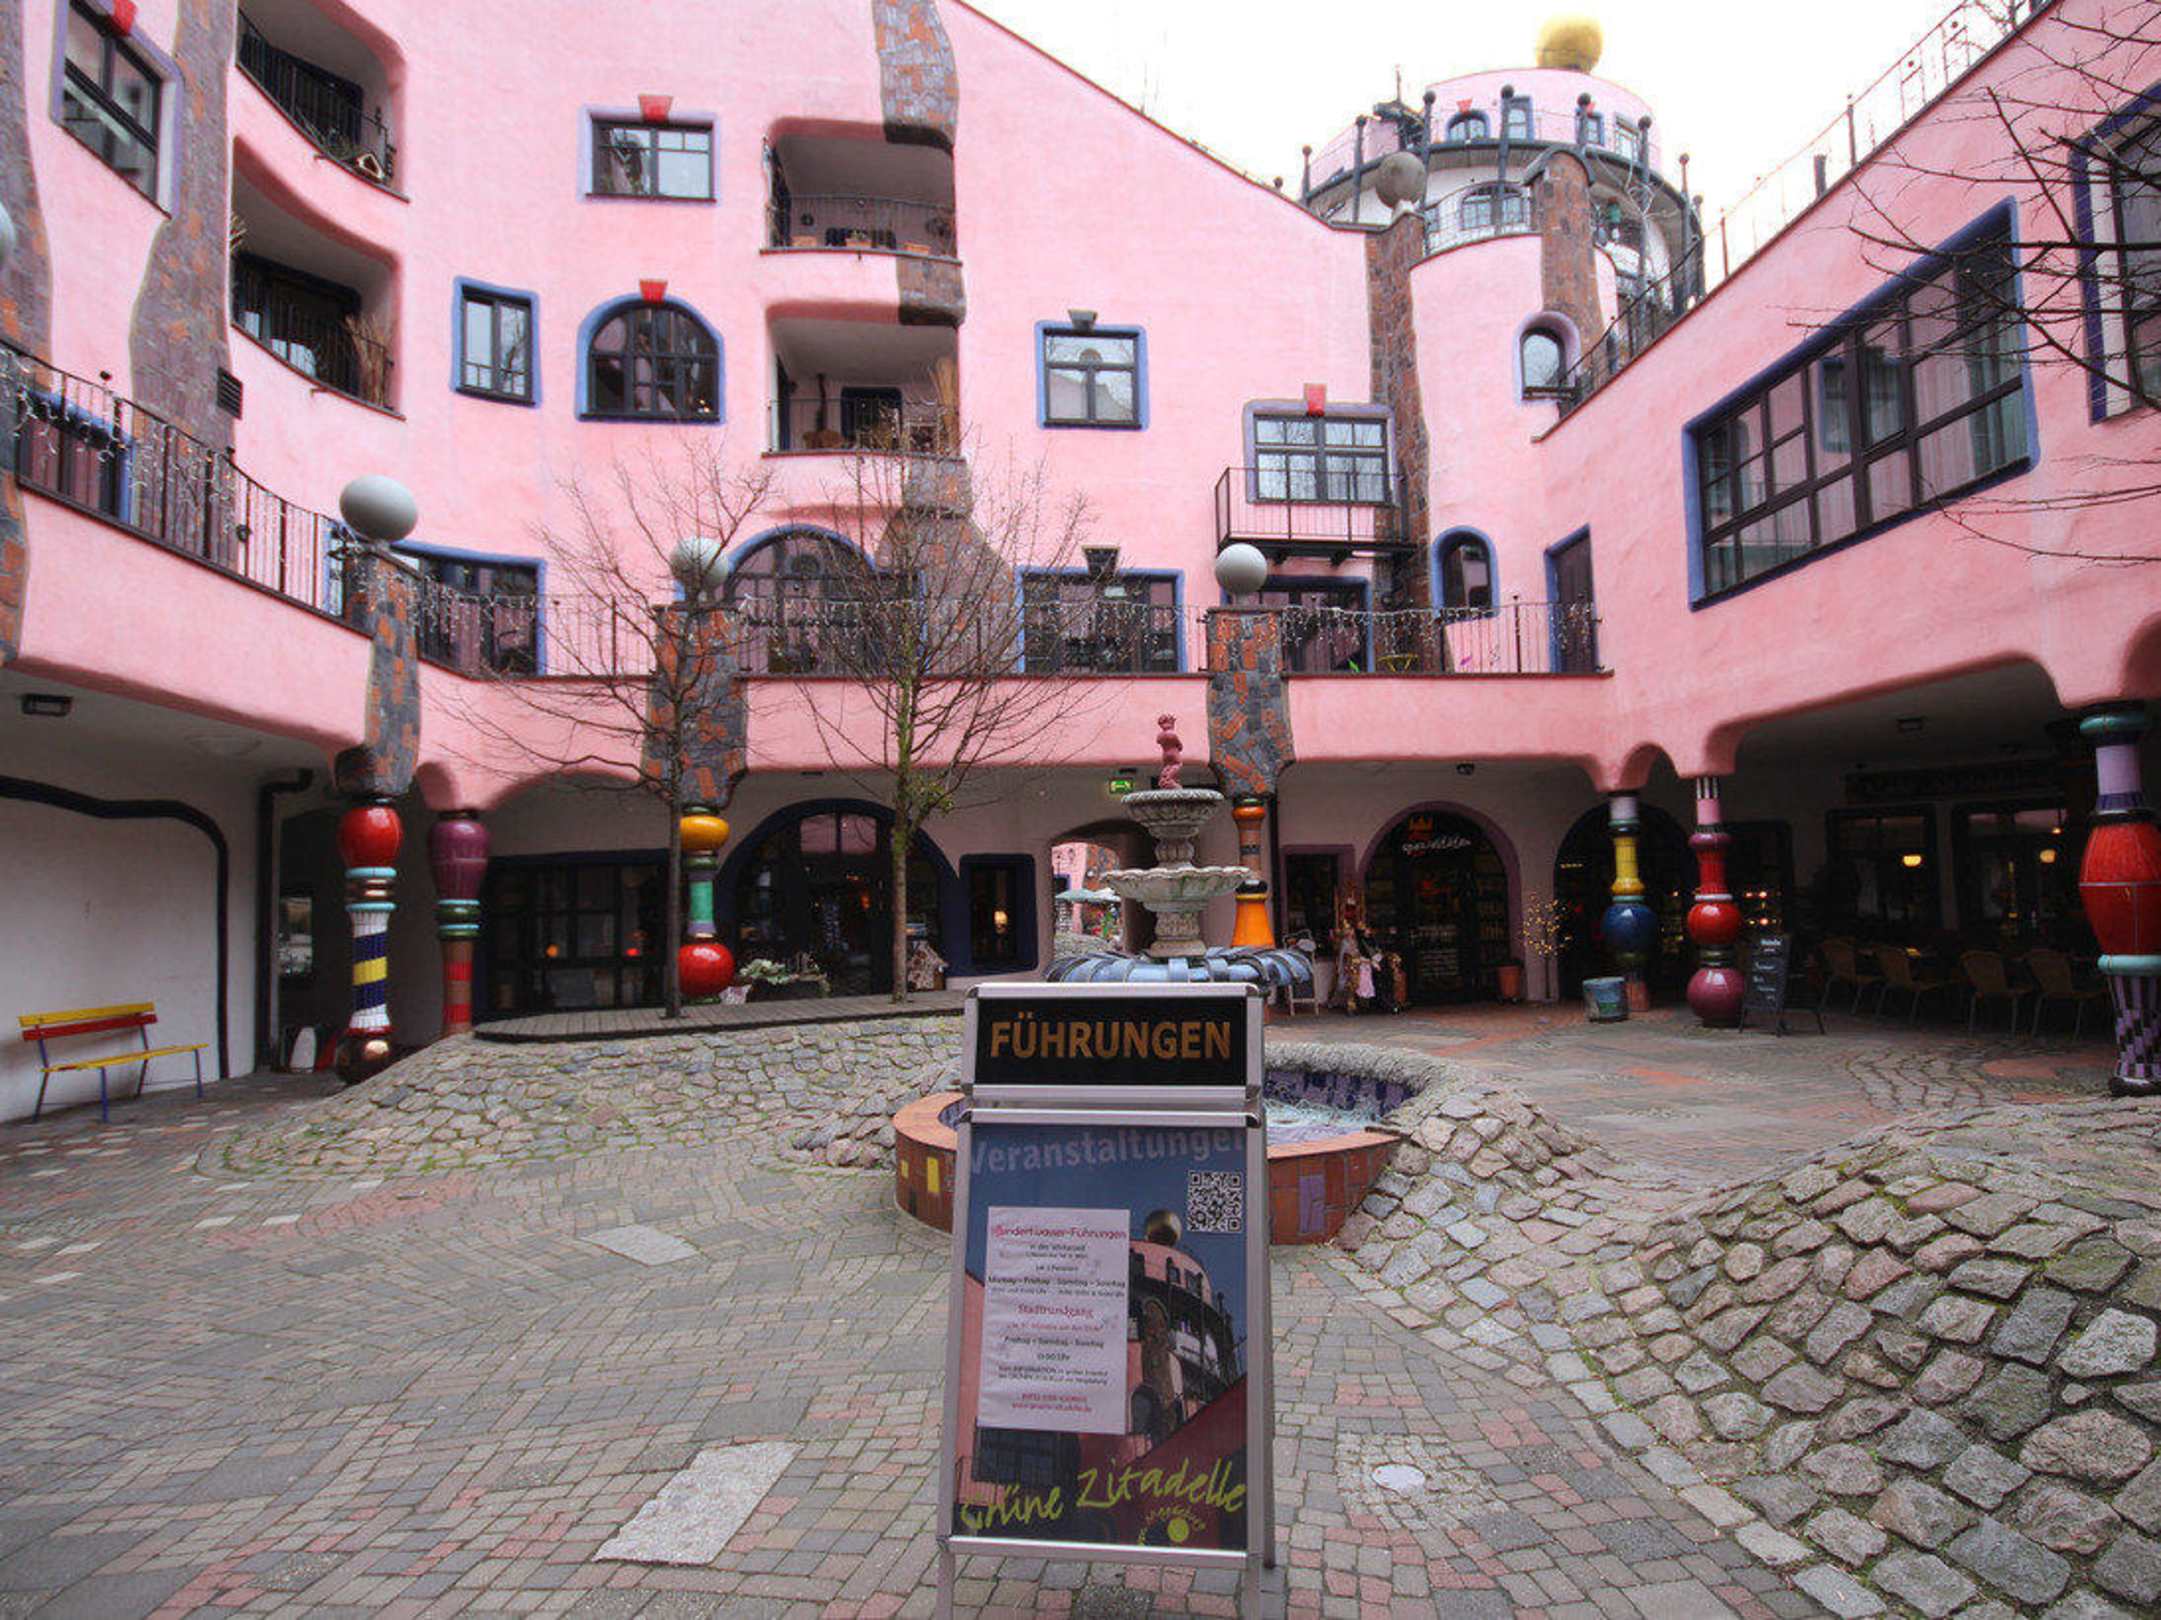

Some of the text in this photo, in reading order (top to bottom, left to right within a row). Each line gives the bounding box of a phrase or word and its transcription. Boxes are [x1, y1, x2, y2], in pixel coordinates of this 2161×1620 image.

[990, 1010, 1231, 1060] FÜHRUNGEN
[960, 1457, 1246, 1530] Grüne Zitadelle
